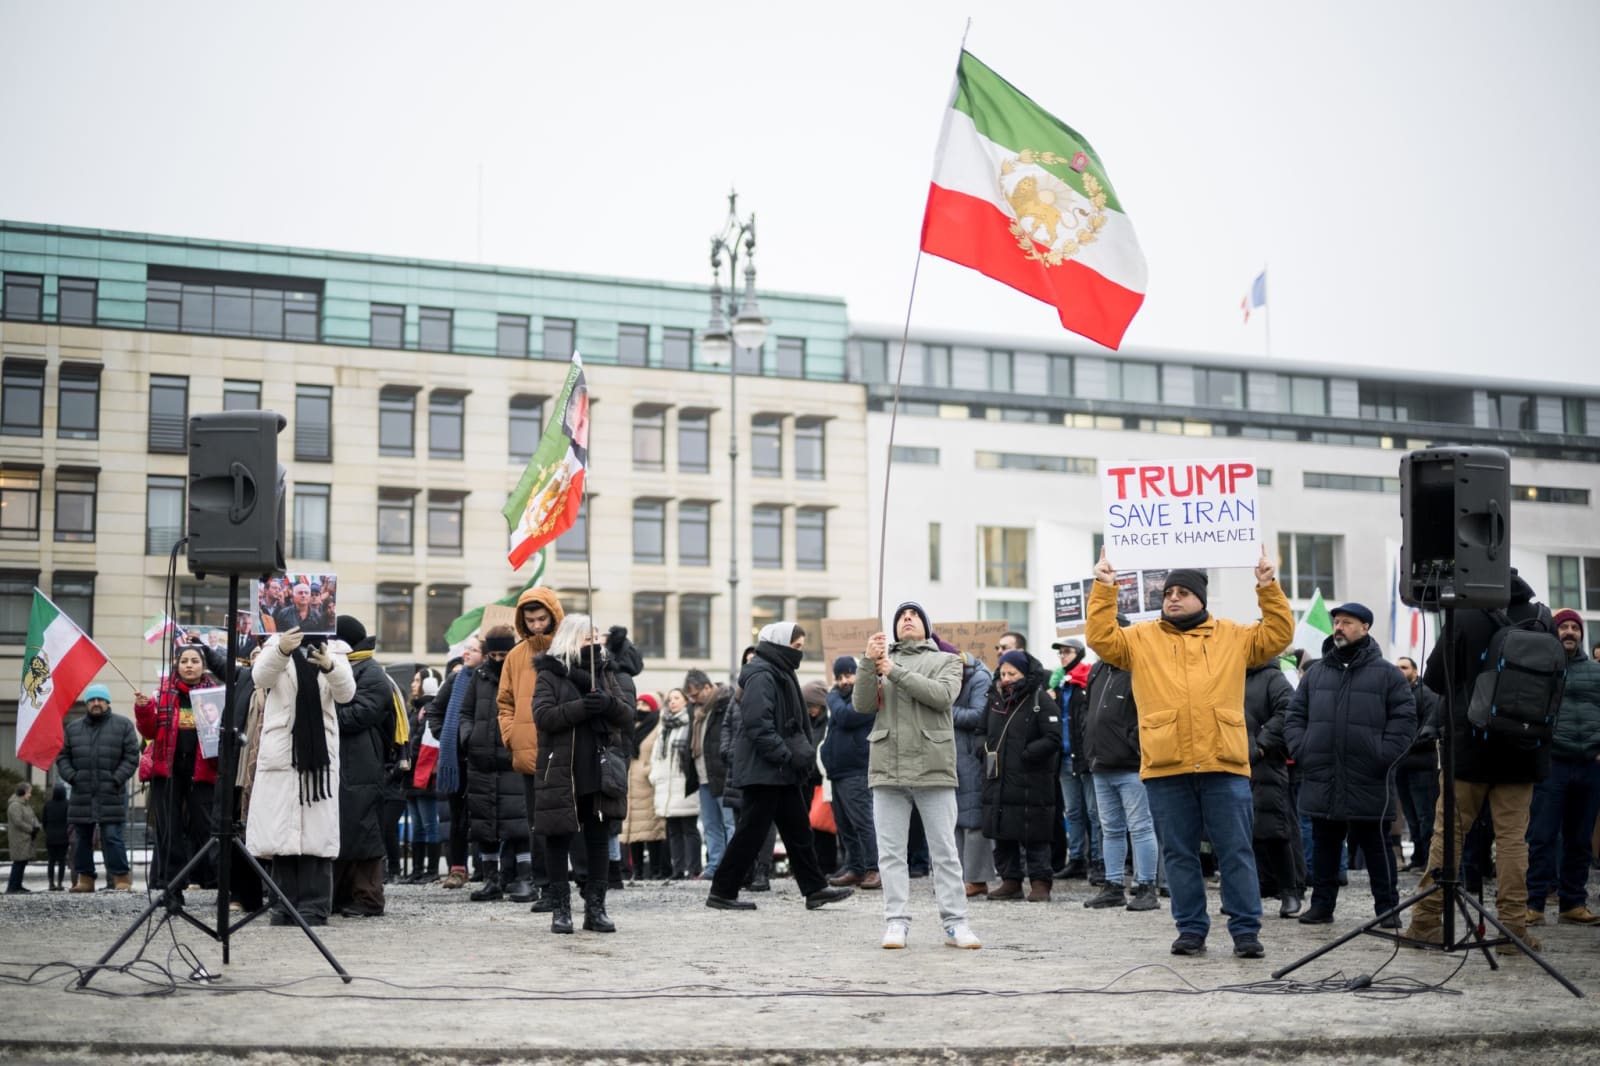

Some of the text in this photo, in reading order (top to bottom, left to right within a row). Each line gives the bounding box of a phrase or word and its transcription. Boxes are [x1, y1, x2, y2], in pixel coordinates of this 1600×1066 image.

[1107, 463, 1254, 500] TRUMP
[1109, 499, 1255, 528] SAVE IRAN
[1111, 528, 1255, 546] TARGET KHAMENEI
